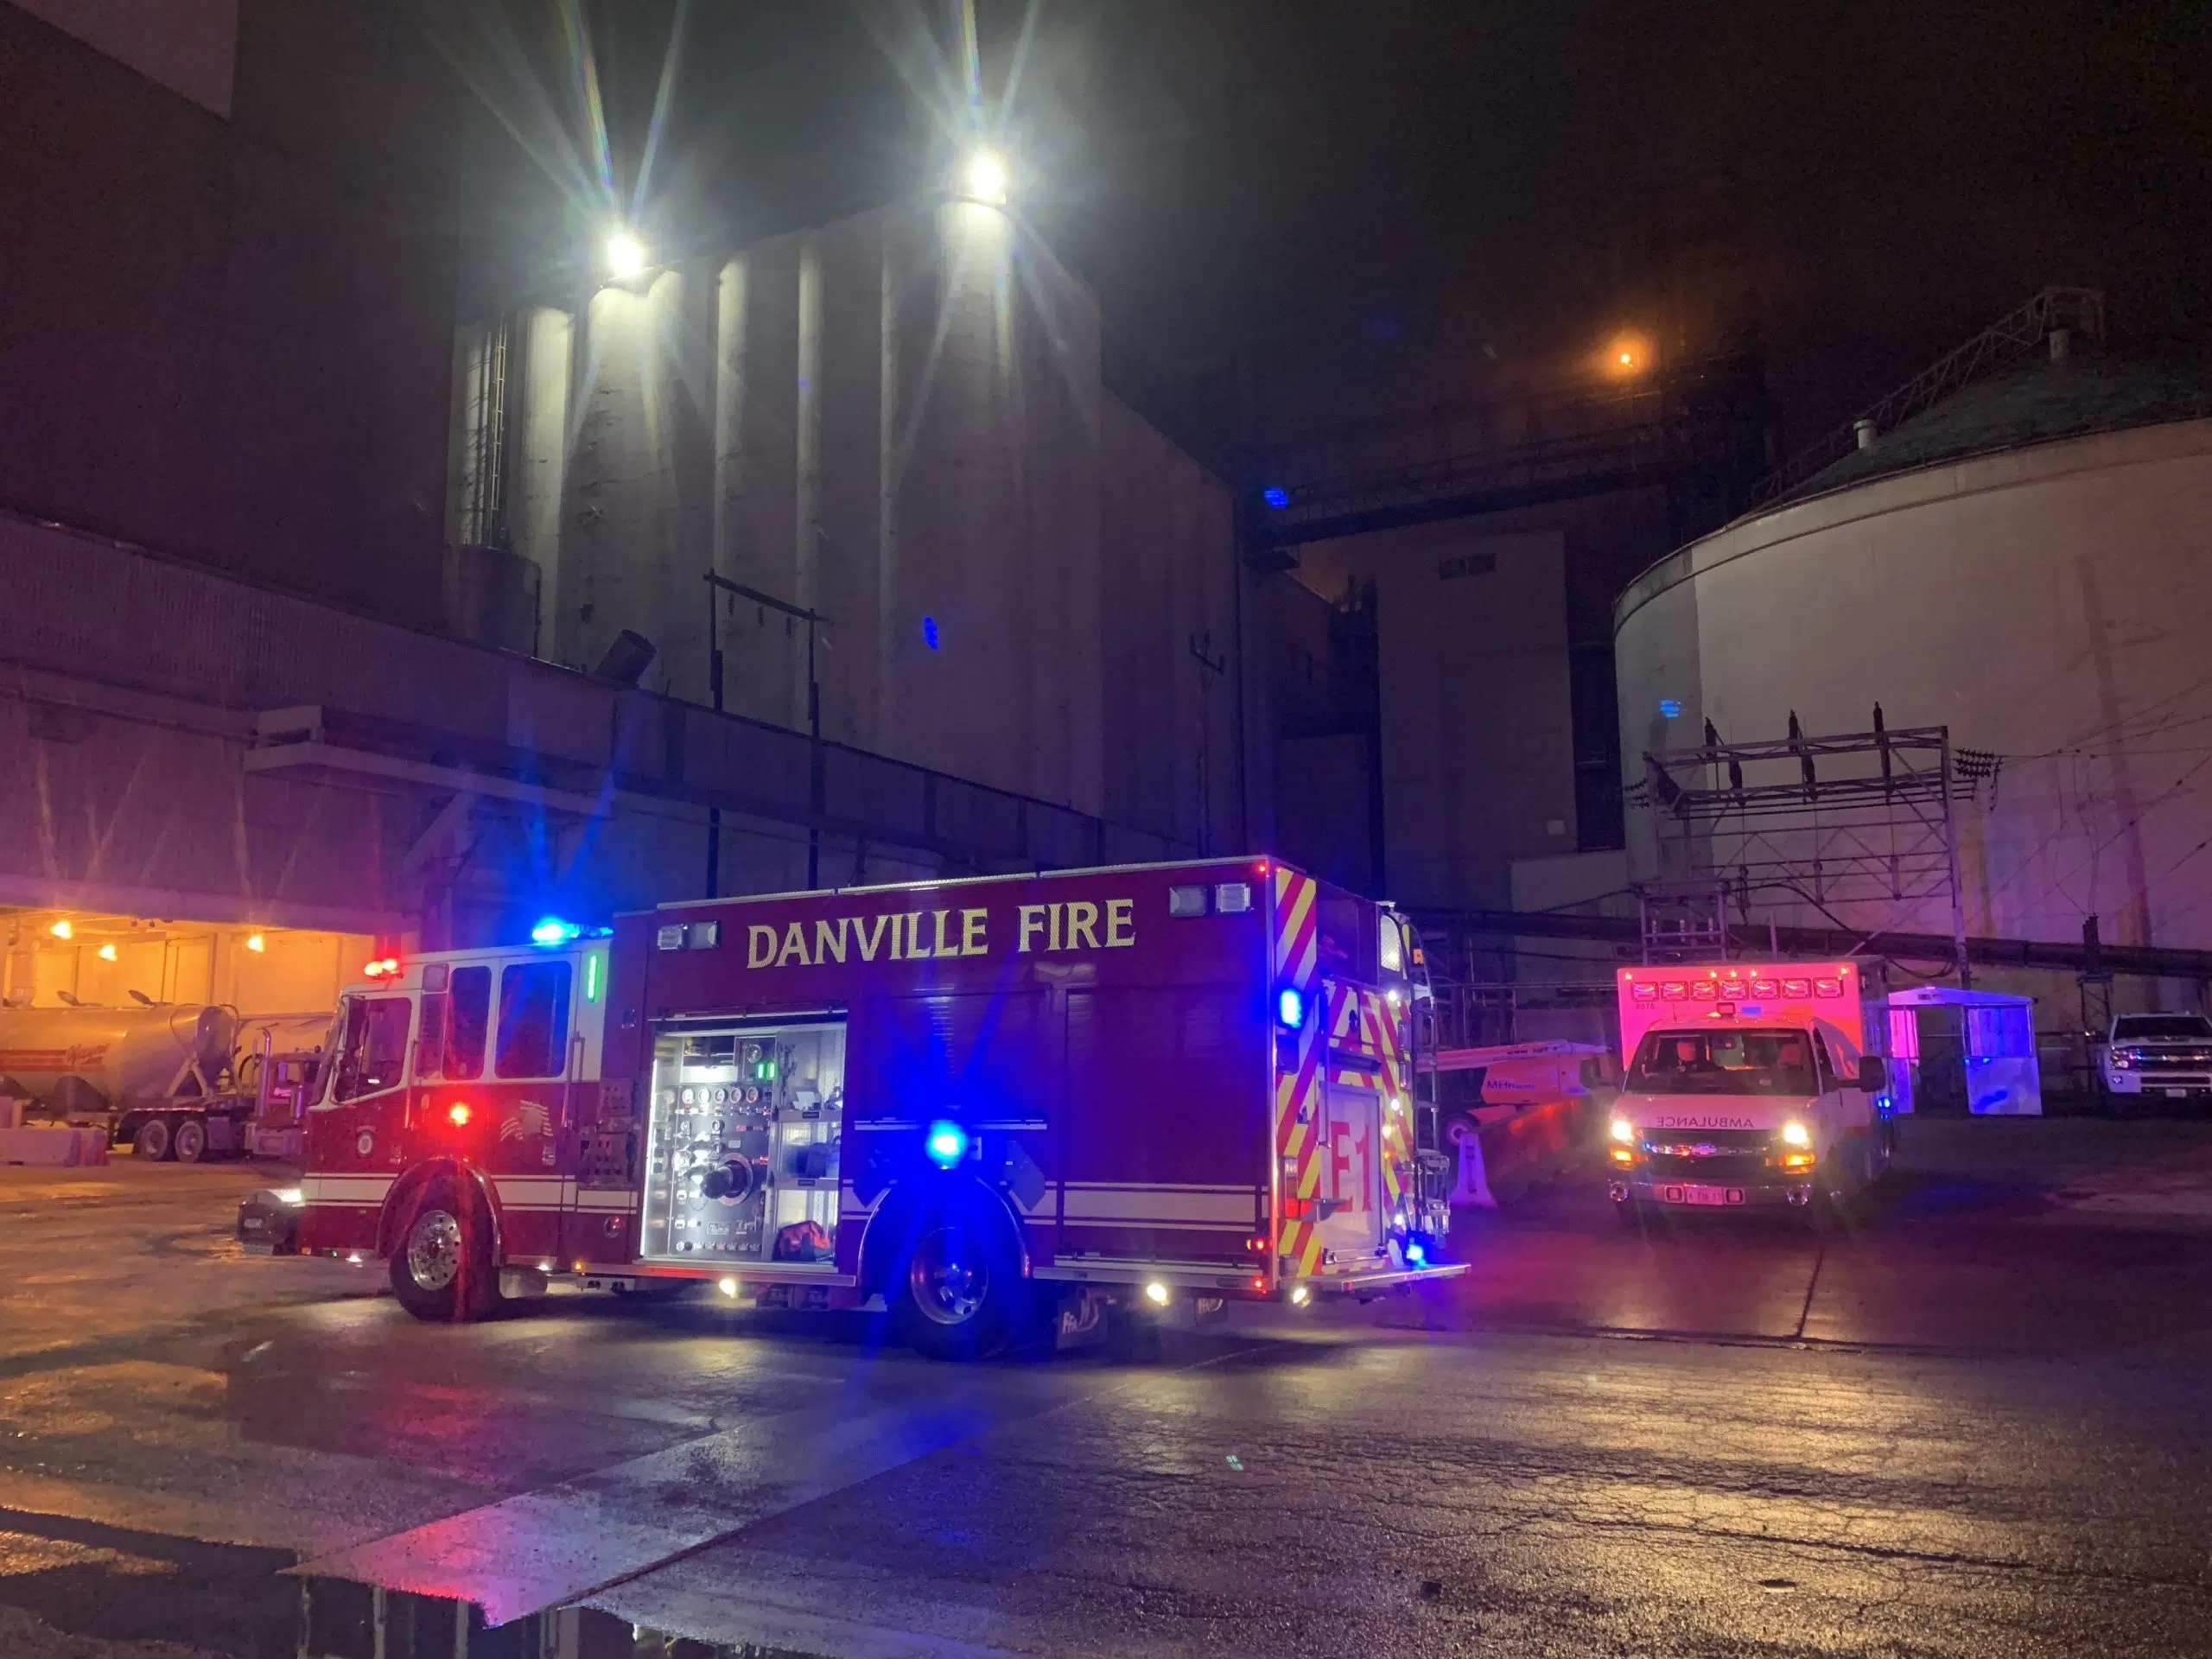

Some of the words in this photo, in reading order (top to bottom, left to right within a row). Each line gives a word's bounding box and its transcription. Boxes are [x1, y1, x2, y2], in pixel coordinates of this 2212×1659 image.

[747, 907, 988, 969] DANVILLE
[1016, 899, 1136, 952] FIRE
[1331, 1121, 1373, 1212] E1
